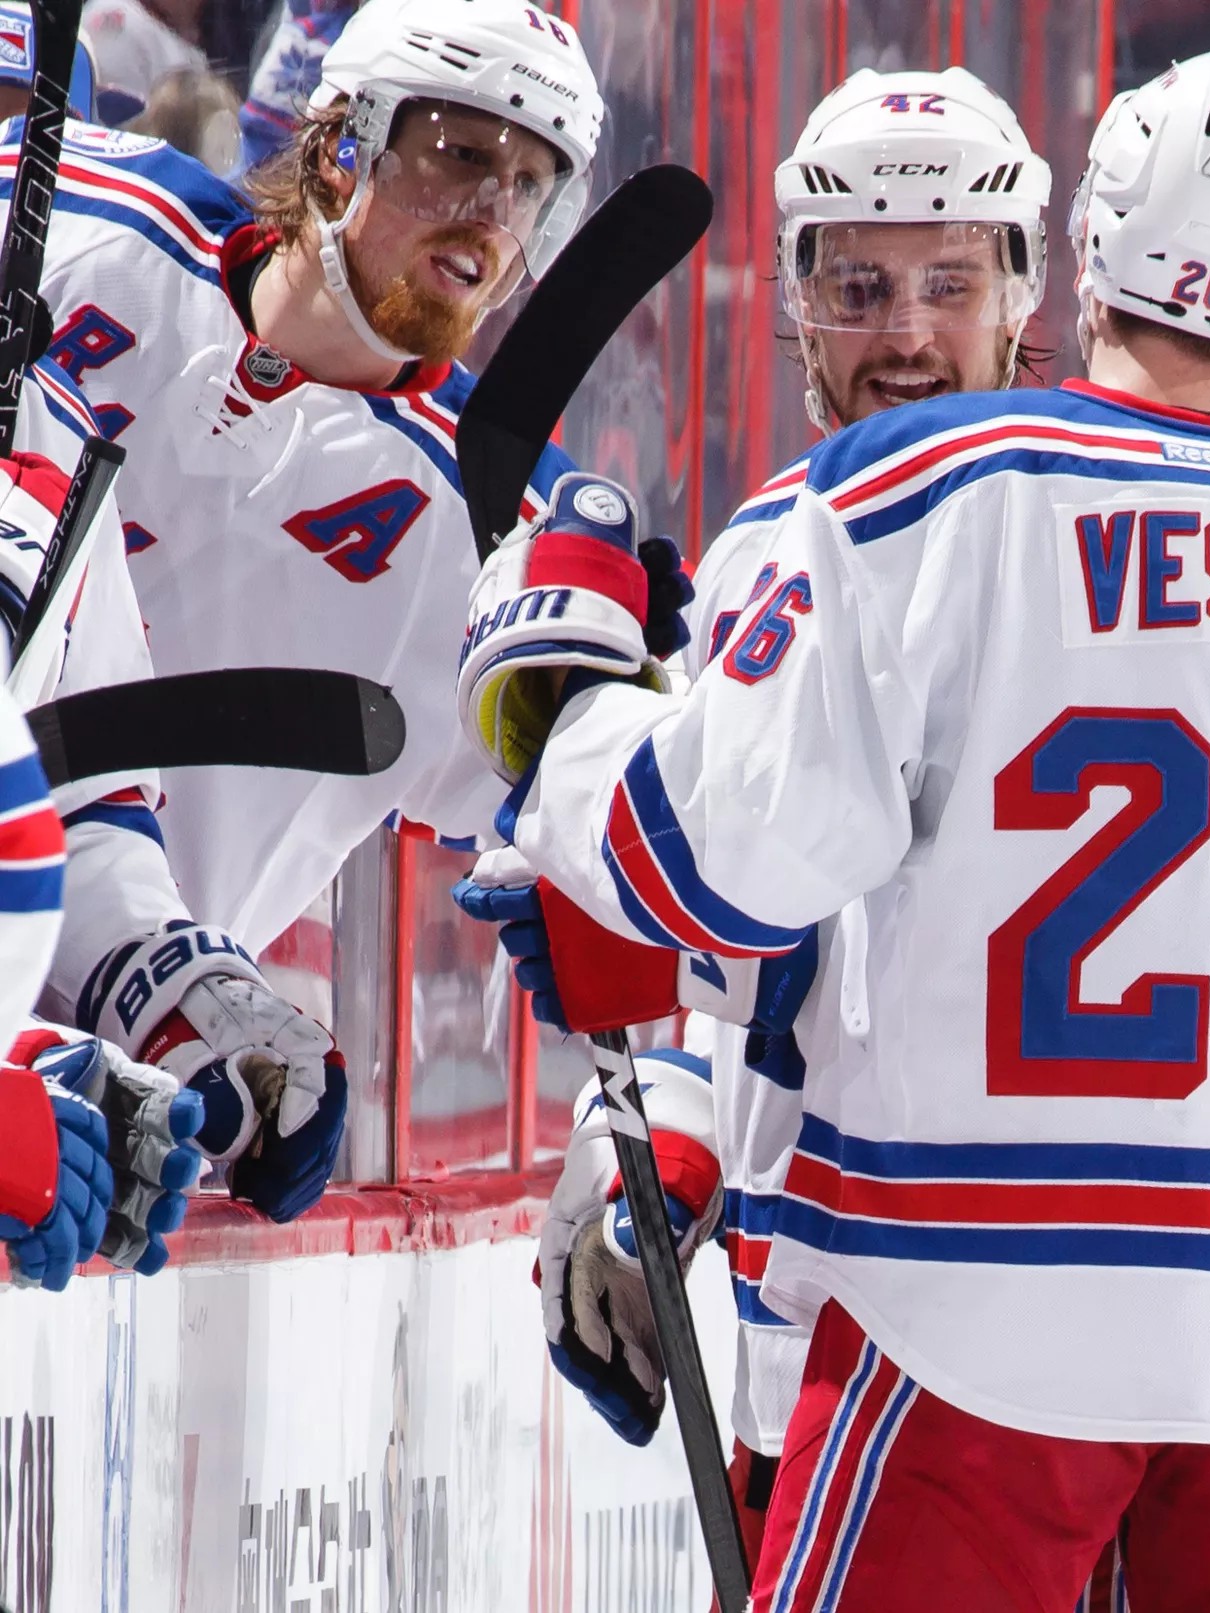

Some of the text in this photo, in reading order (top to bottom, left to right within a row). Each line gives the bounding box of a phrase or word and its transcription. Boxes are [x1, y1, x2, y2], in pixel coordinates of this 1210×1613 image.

[511, 63, 579, 102] BAUER
[873, 164, 949, 176] CCM
[281, 478, 432, 584] A
